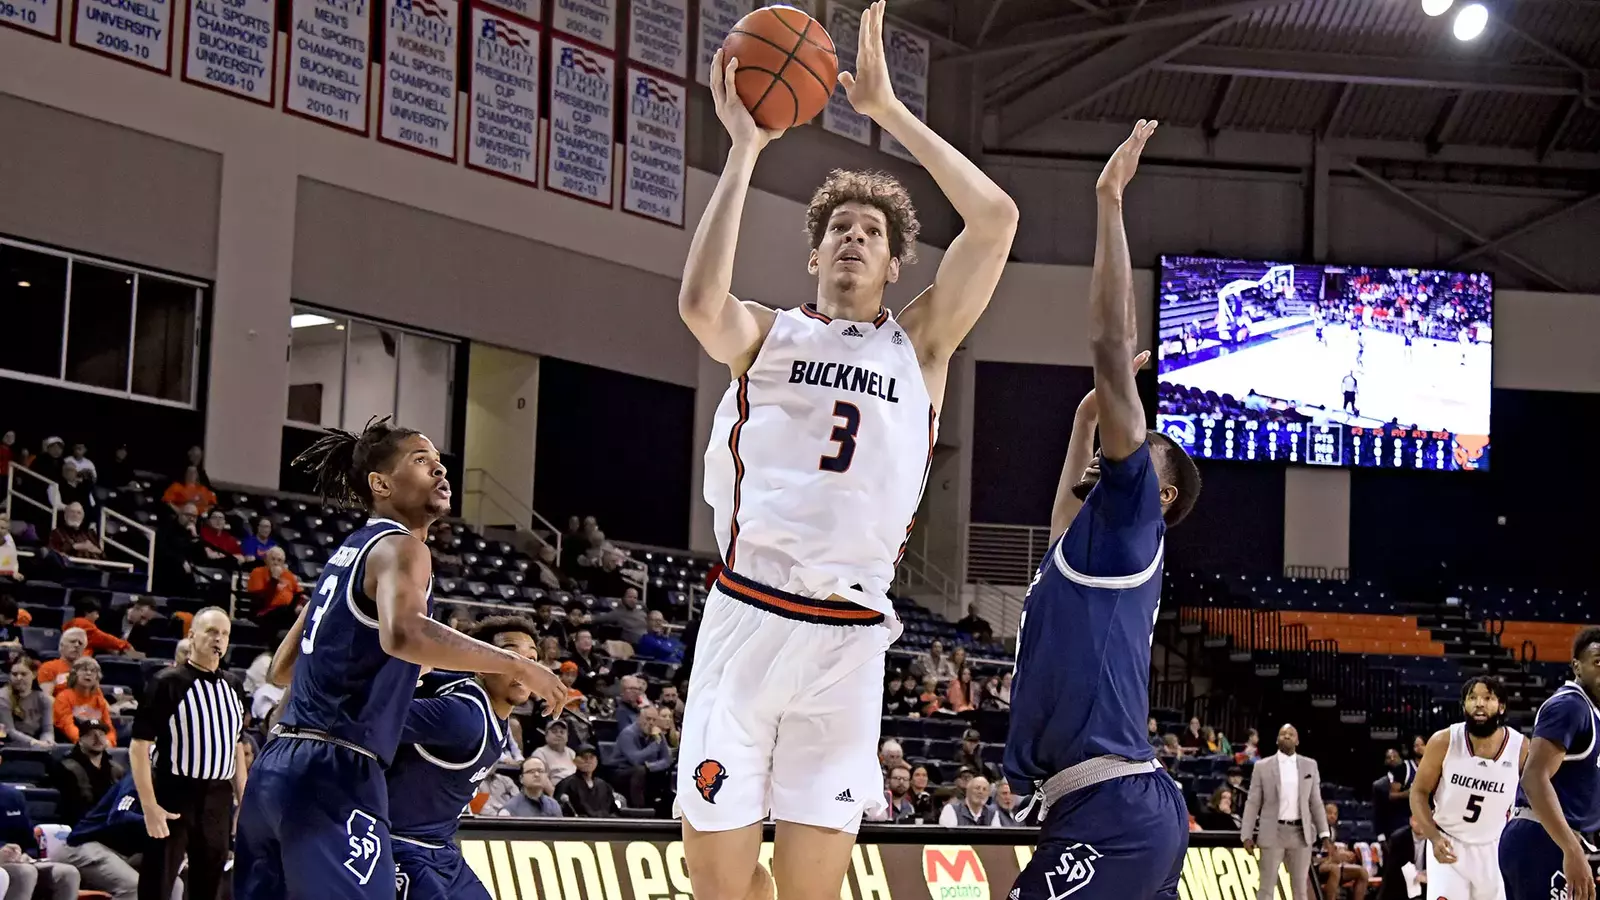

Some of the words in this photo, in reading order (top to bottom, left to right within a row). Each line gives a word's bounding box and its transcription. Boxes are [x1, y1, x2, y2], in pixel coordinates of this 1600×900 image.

[85, 5, 162, 41] UNIVERSITY
[196, 15, 268, 50] CHAMPIONS
[223, 7, 271, 34] SPORTS
[95, 31, 150, 59] 2009-10
[199, 32, 263, 64] BUCKNELL
[296, 19, 320, 38] ALL
[320, 27, 366, 53] SPORTS
[195, 46, 266, 79] UNIVERSITY
[297, 37, 365, 71] CHAMPIONS
[389, 51, 410, 69] ALL
[412, 58, 453, 82] SPORTS
[205, 66, 255, 92] 2009-10
[299, 56, 360, 87] BUCKNELL
[389, 69, 452, 99] CHAMPIONS
[296, 74, 361, 105] UNIVERSITY
[391, 86, 448, 116] BUCKNELL
[494, 84, 515, 100] CUP
[306, 98, 349, 121] 2010-11
[389, 103, 449, 132] UNIVERSITY
[475, 92, 493, 108] ALL
[495, 99, 535, 121] SPORTS
[571, 110, 593, 125] CUP
[475, 107, 533, 135] CHAMPIONS
[477, 121, 530, 148] BUCKNELL
[554, 118, 570, 132] ALL
[573, 125, 610, 146] SPORTS
[399, 127, 440, 150] 2010-11
[475, 136, 532, 162] UNIVERSITY
[554, 132, 609, 160] CHAMPIONS
[630, 136, 646, 149] ALL
[649, 141, 682, 161] SPORTS
[485, 153, 523, 174] 2010-11
[553, 160, 608, 186] UNIVERSITY
[556, 146, 606, 172] BUCKNELL
[630, 150, 681, 176] CHAMPIONS
[562, 176, 599, 197] 2012-13
[630, 180, 680, 202] UNIVERSITY
[632, 166, 677, 190] BUCKNELL
[789, 360, 899, 403] BUCKNELL
[819, 400, 861, 473] 3
[301, 574, 339, 655] 3
[1450, 773, 1505, 794] BUCKNELL
[1462, 794, 1485, 823] 5
[925, 850, 985, 882] M
[940, 884, 982, 899] potato
